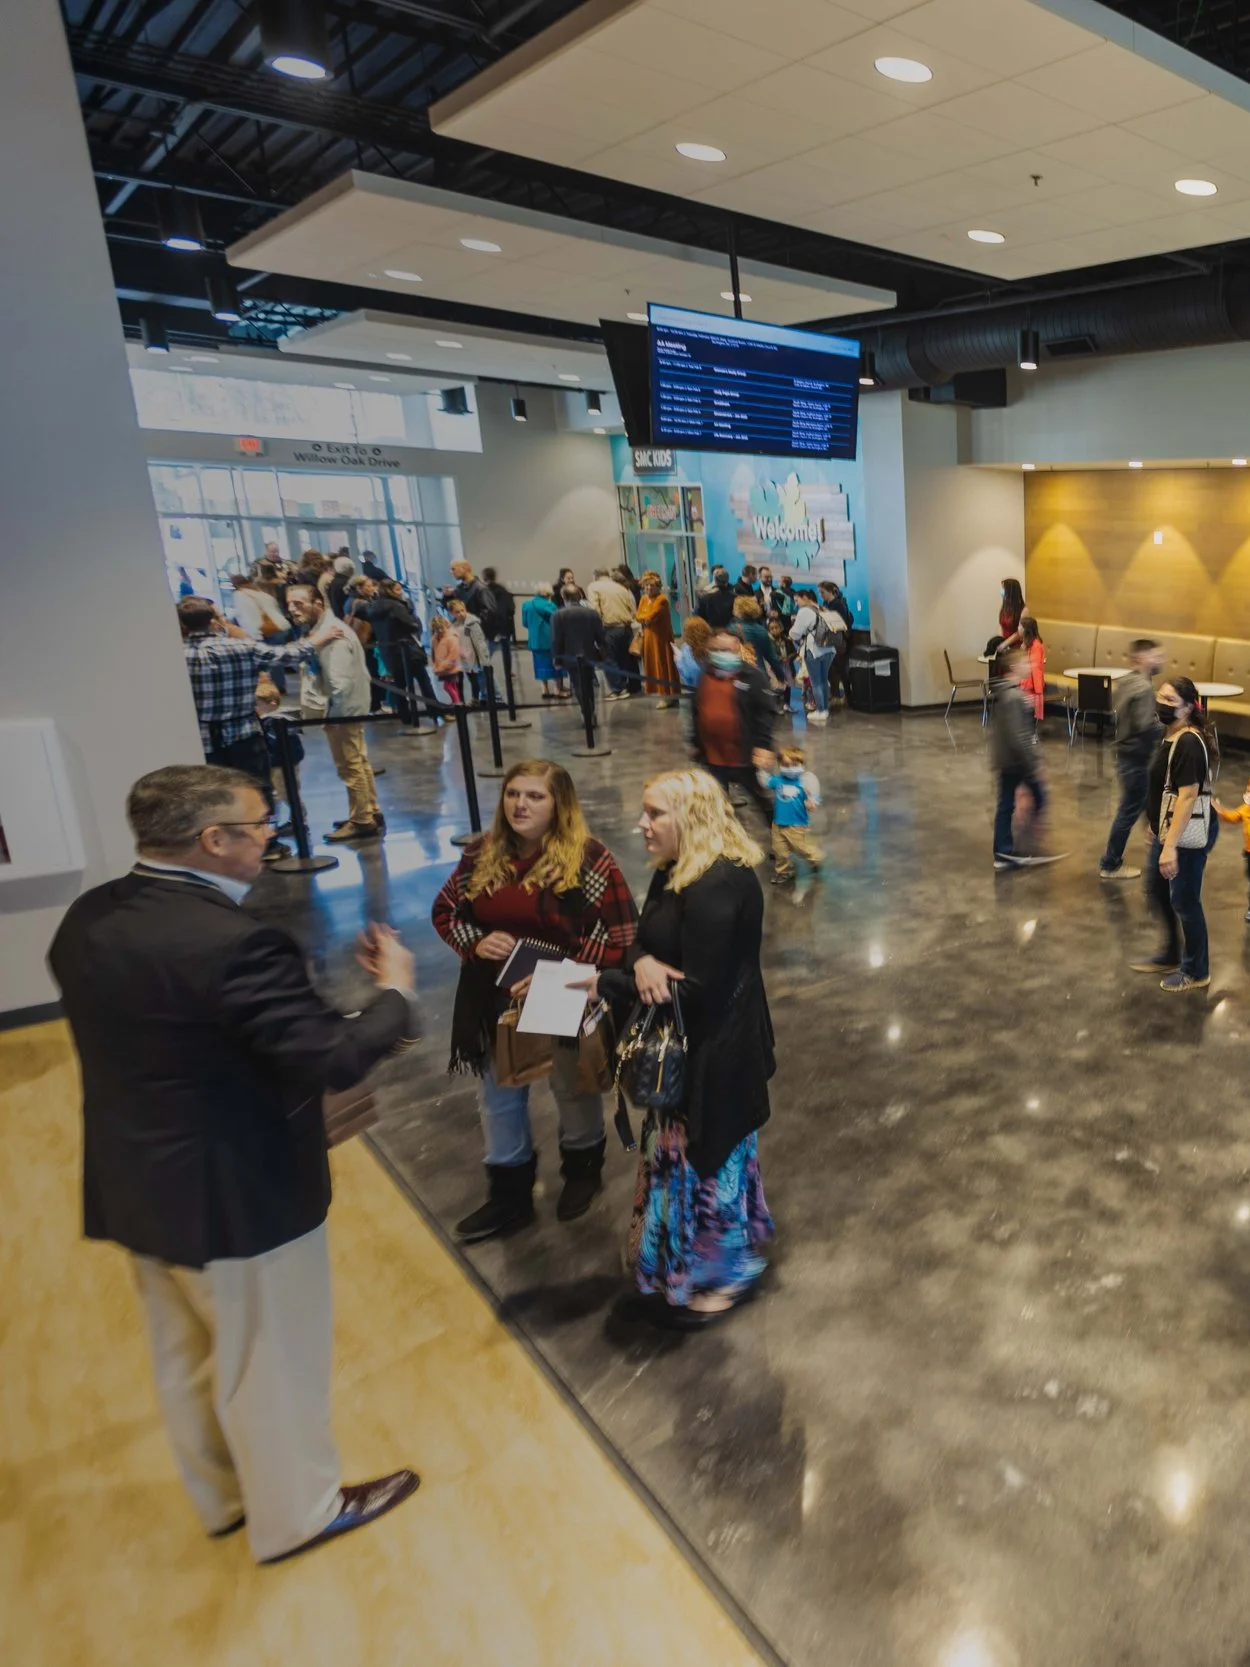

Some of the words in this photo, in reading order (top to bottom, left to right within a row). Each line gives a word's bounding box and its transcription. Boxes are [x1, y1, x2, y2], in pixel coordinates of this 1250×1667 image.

[326, 443, 350, 454] Exit
[353, 445, 367, 455] To
[293, 451, 337, 464] Willow
[341, 455, 365, 466] Oak
[368, 457, 400, 468] Drive
[635, 449, 652, 467] SMC
[652, 449, 672, 467] KIDS
[753, 515, 822, 541] Welcome!
